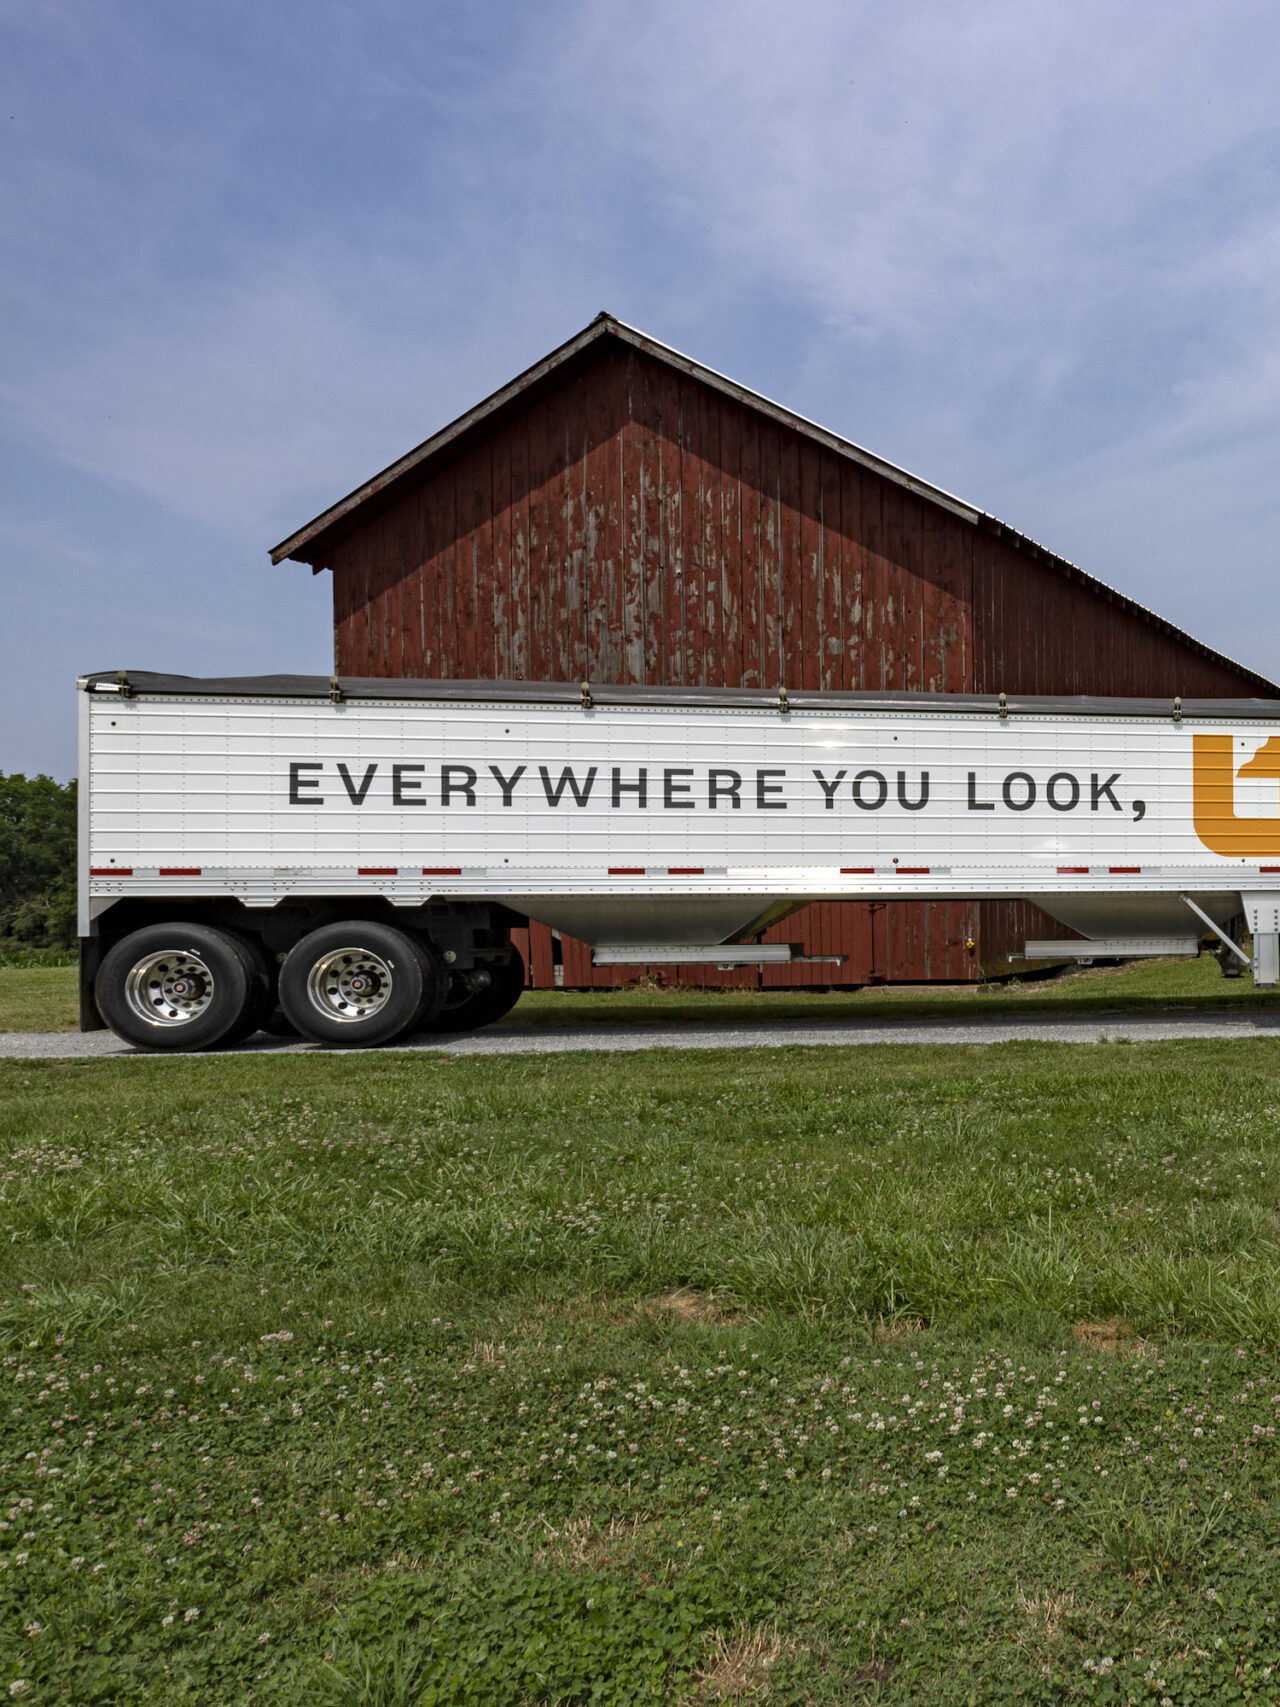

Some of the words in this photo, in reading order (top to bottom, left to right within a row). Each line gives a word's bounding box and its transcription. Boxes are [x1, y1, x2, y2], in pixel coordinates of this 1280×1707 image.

[288, 762, 788, 810] EVERYWHERE
[812, 769, 930, 811] YOU
[967, 771, 1147, 823] LOOK,
